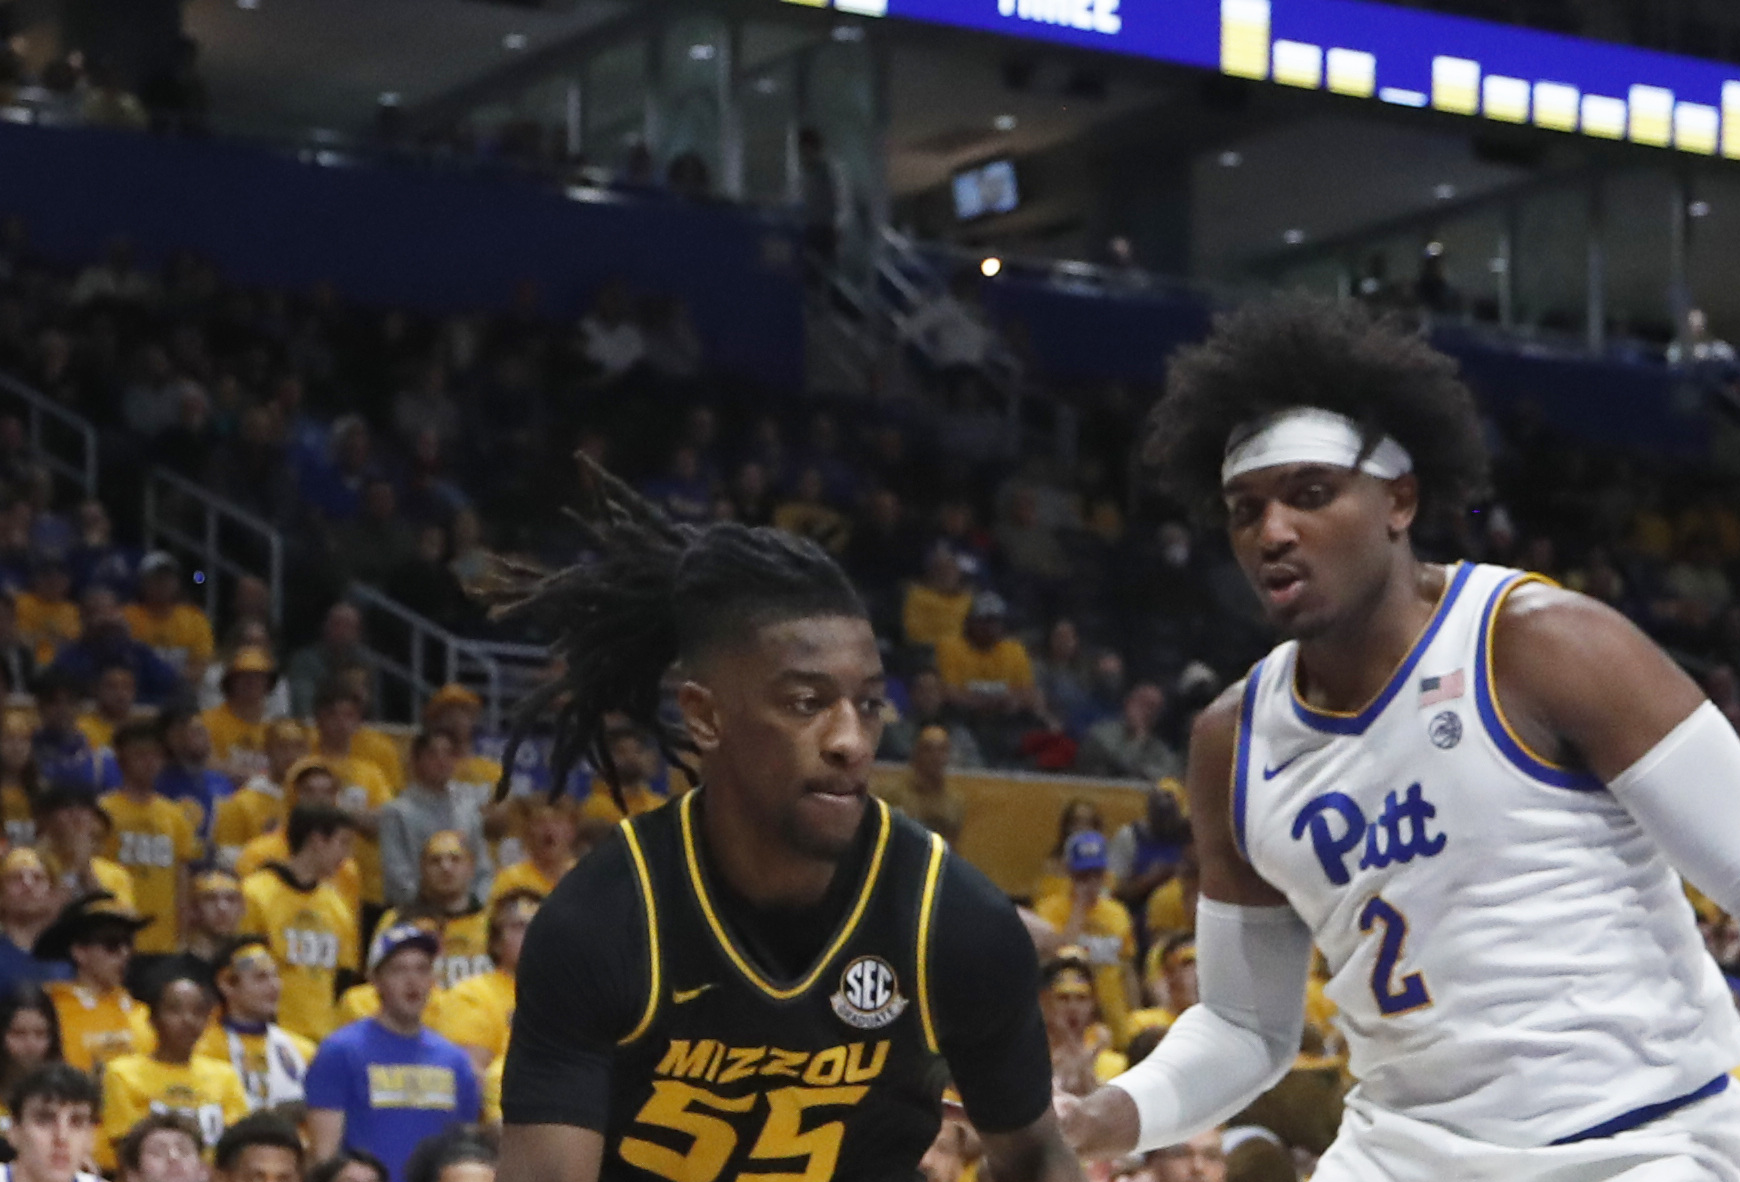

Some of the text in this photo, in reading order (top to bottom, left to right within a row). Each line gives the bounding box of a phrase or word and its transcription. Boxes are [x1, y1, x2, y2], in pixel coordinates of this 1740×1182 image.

[1291, 782, 1447, 886] Pitt
[845, 959, 893, 1011] SEC
[1358, 893, 1434, 1018] 2
[654, 1039, 891, 1086] MIZZOU
